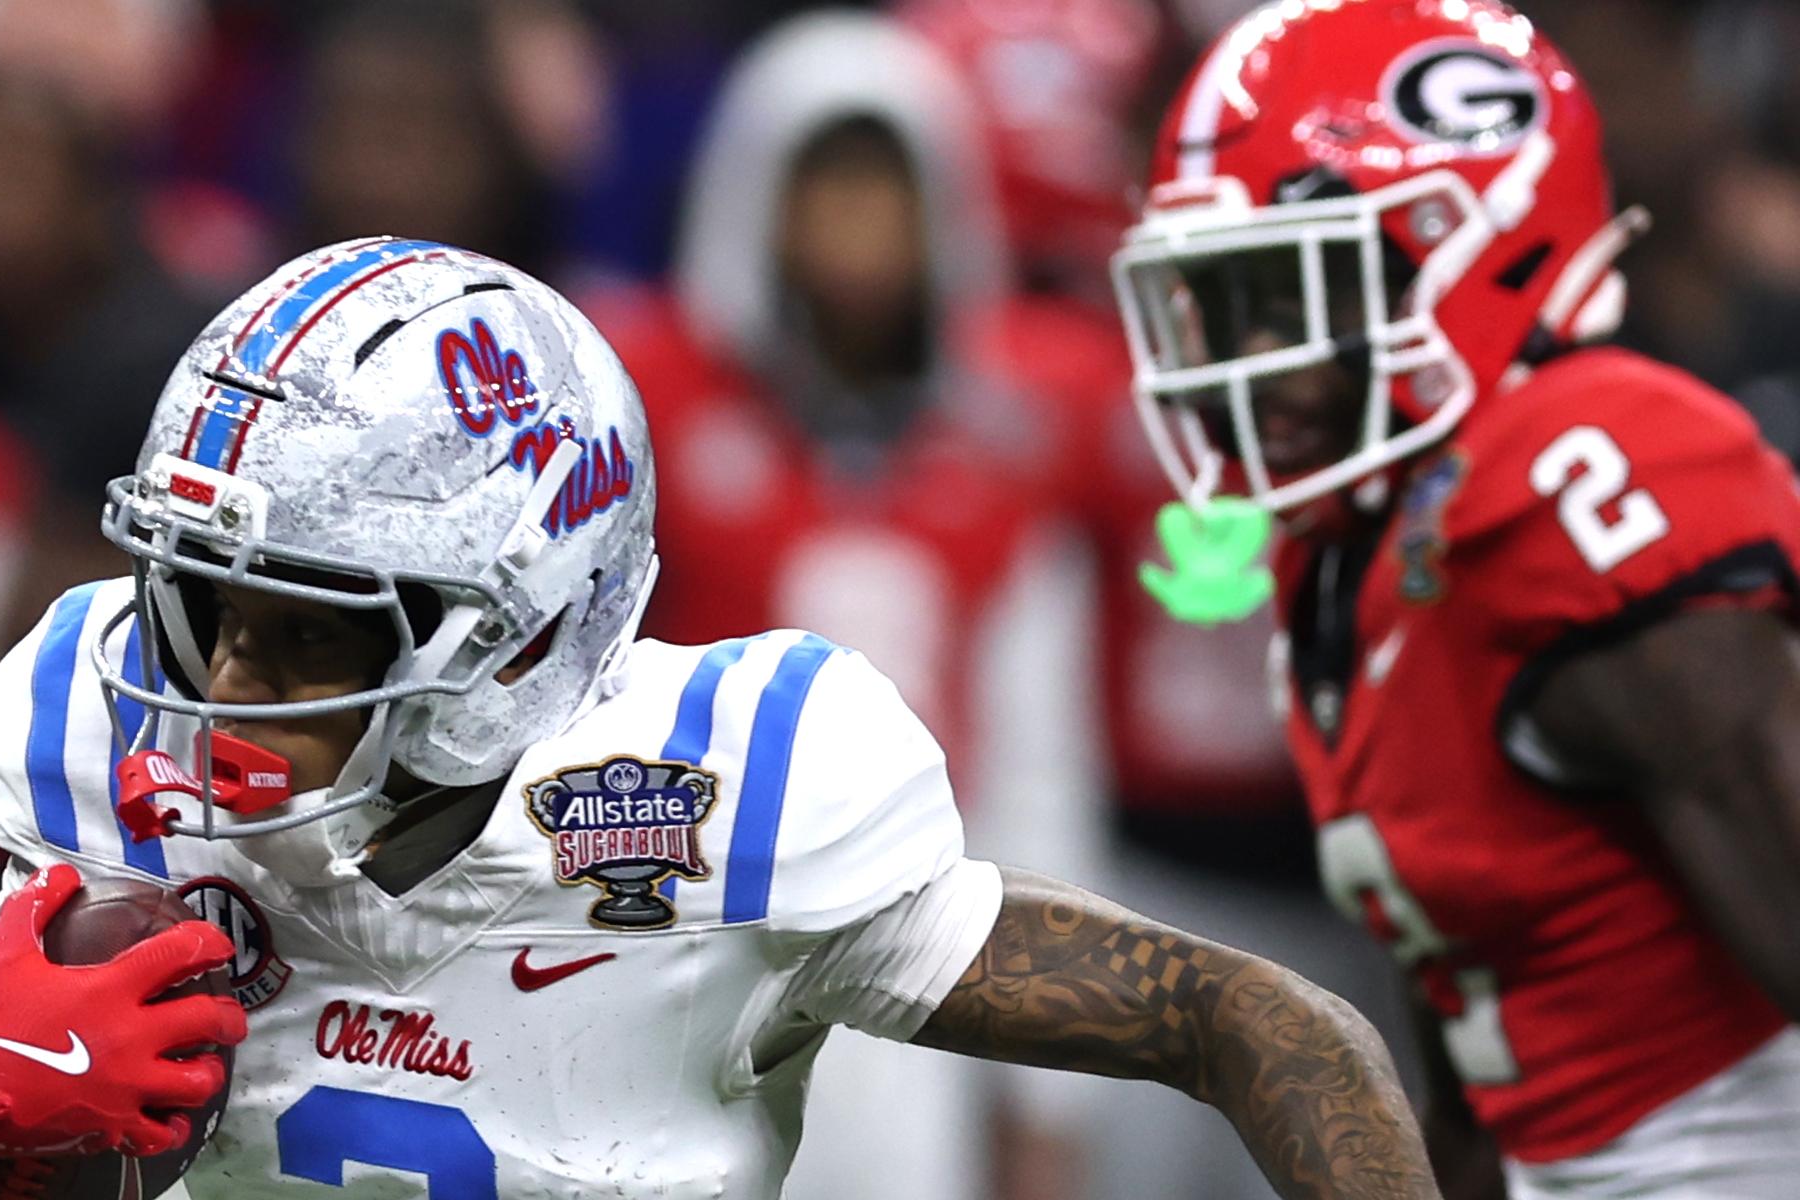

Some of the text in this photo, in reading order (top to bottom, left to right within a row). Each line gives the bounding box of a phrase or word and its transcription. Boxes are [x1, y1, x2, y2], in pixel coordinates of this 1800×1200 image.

[1418, 55, 1539, 129] G
[436, 316, 539, 438] Ole
[1529, 424, 1669, 574] 2
[560, 793, 686, 826] Allstate
[316, 1000, 474, 1081] Ole Miss
